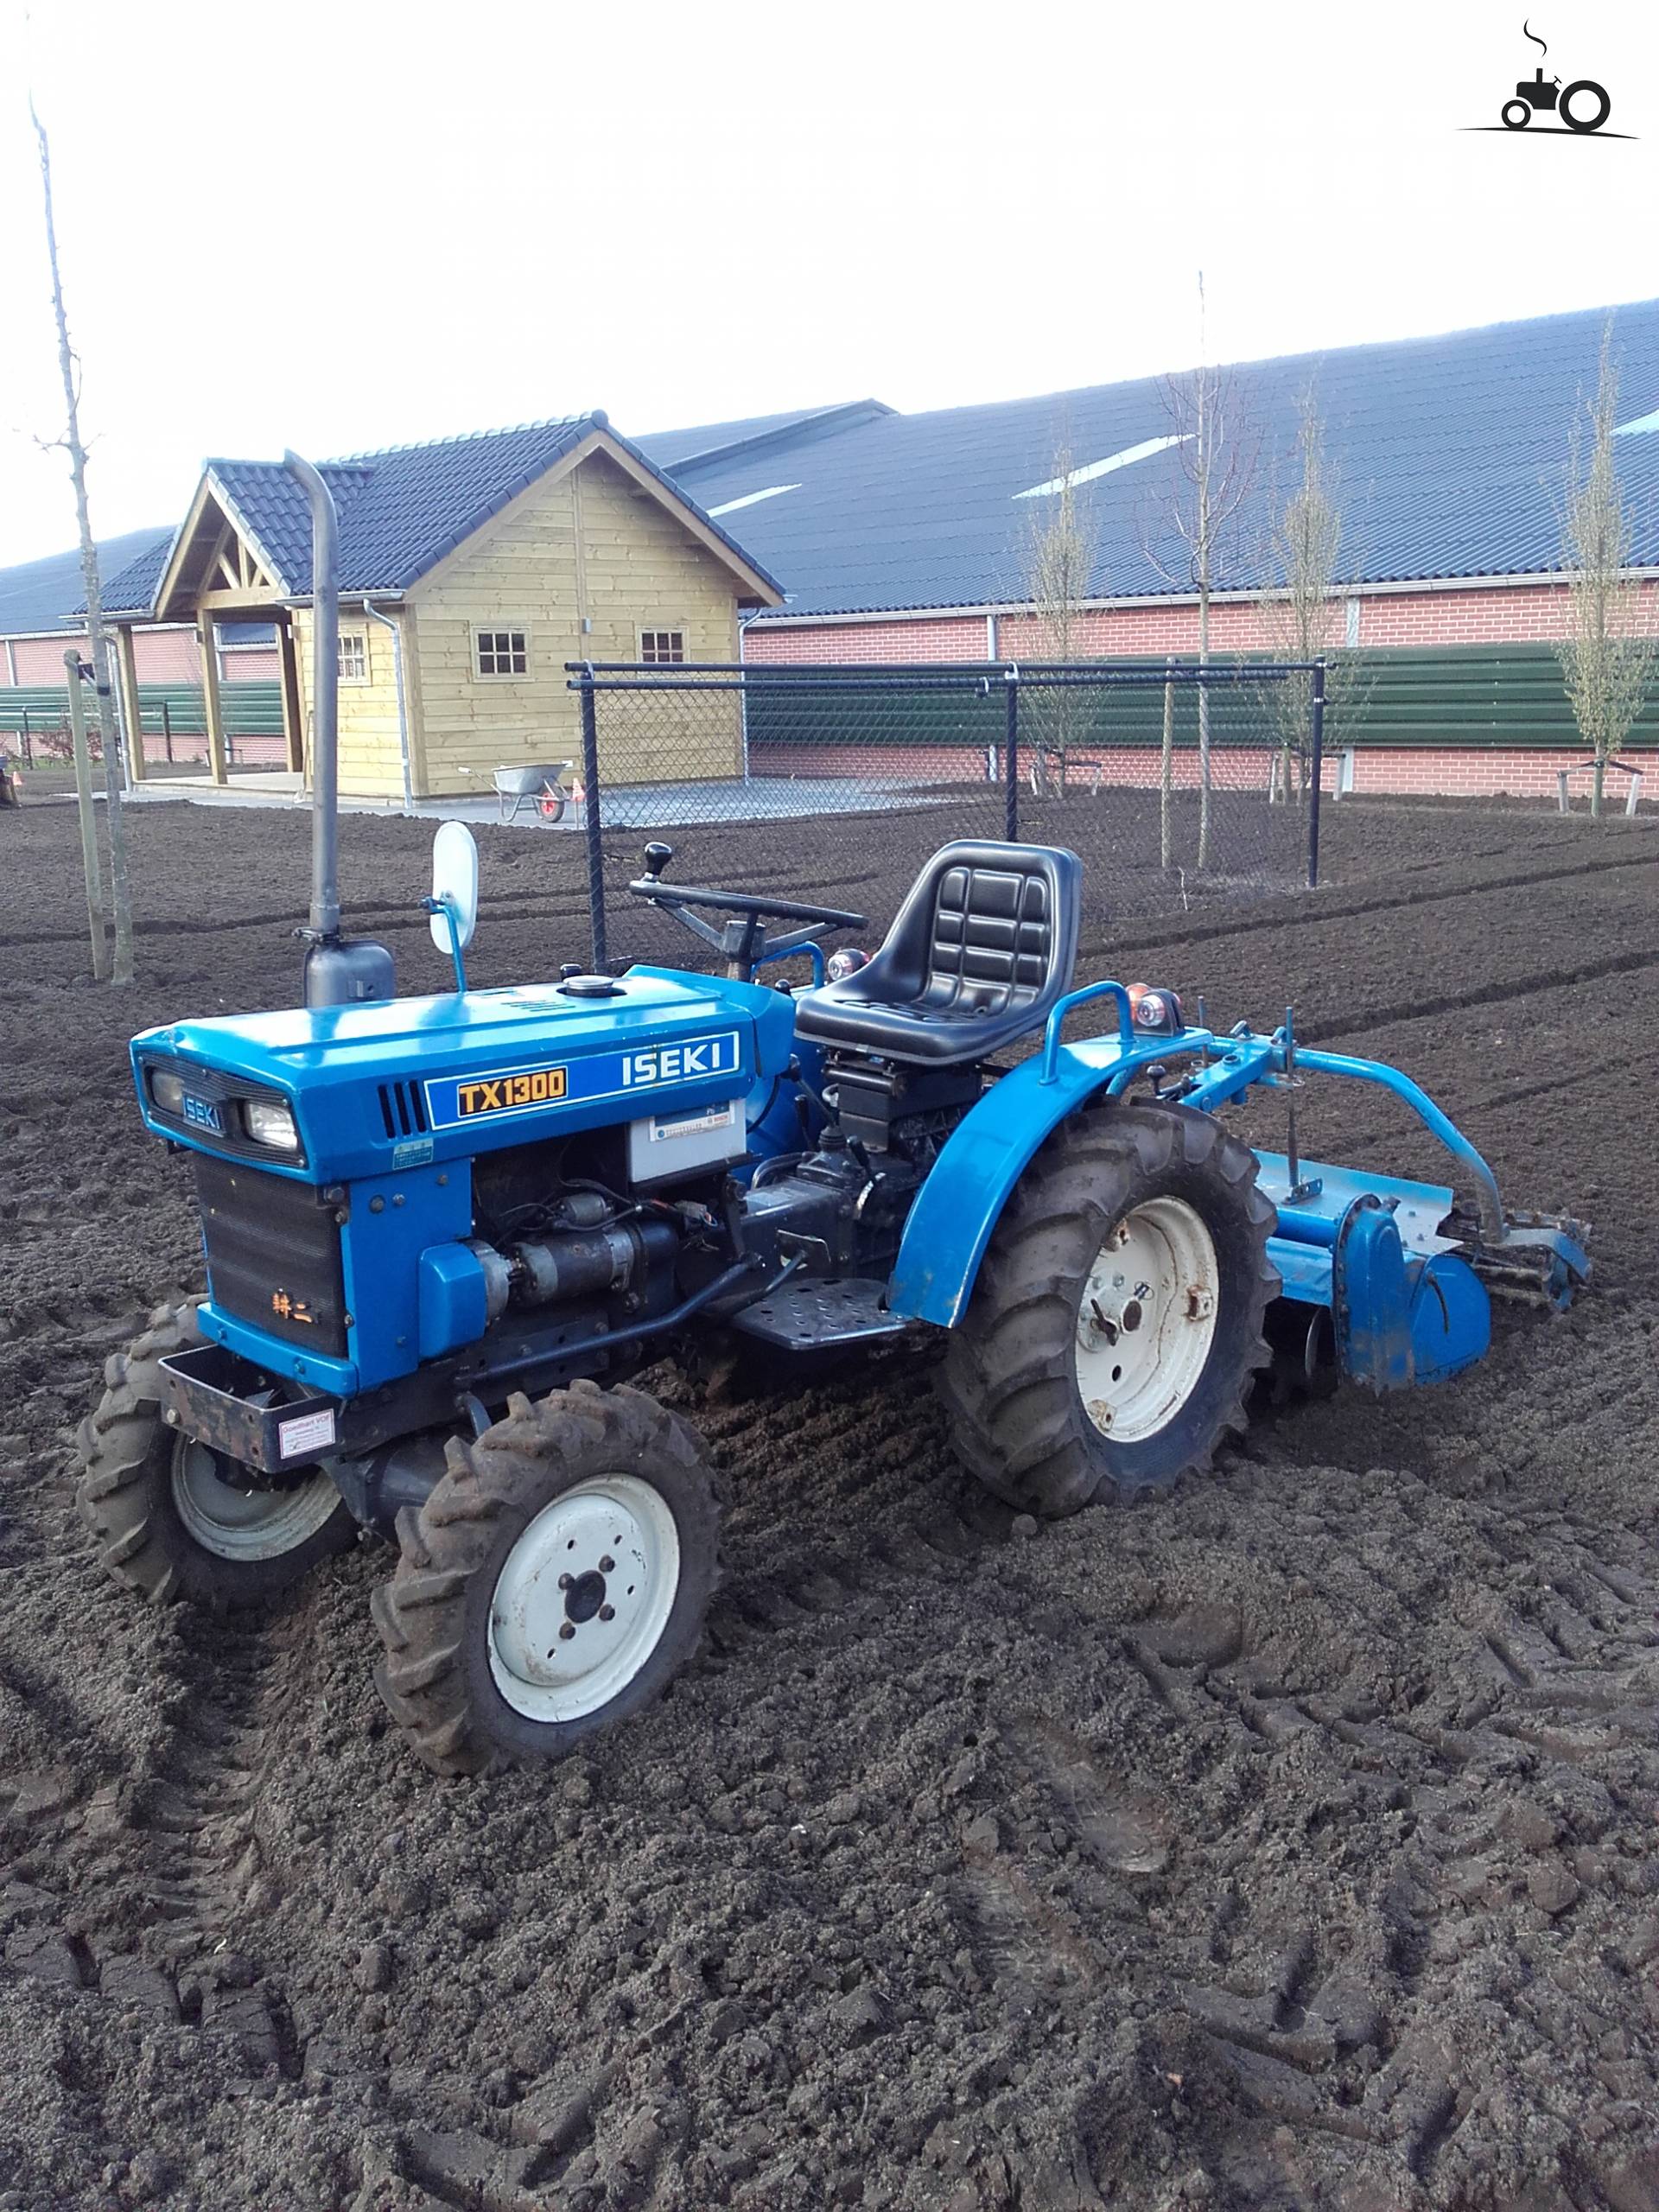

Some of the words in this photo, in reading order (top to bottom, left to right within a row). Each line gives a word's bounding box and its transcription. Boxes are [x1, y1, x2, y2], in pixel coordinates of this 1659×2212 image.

[622, 1042, 720, 1086] ISEKI
[182, 1095, 220, 1129] ISEKI
[459, 1070, 565, 1114] TX1300
